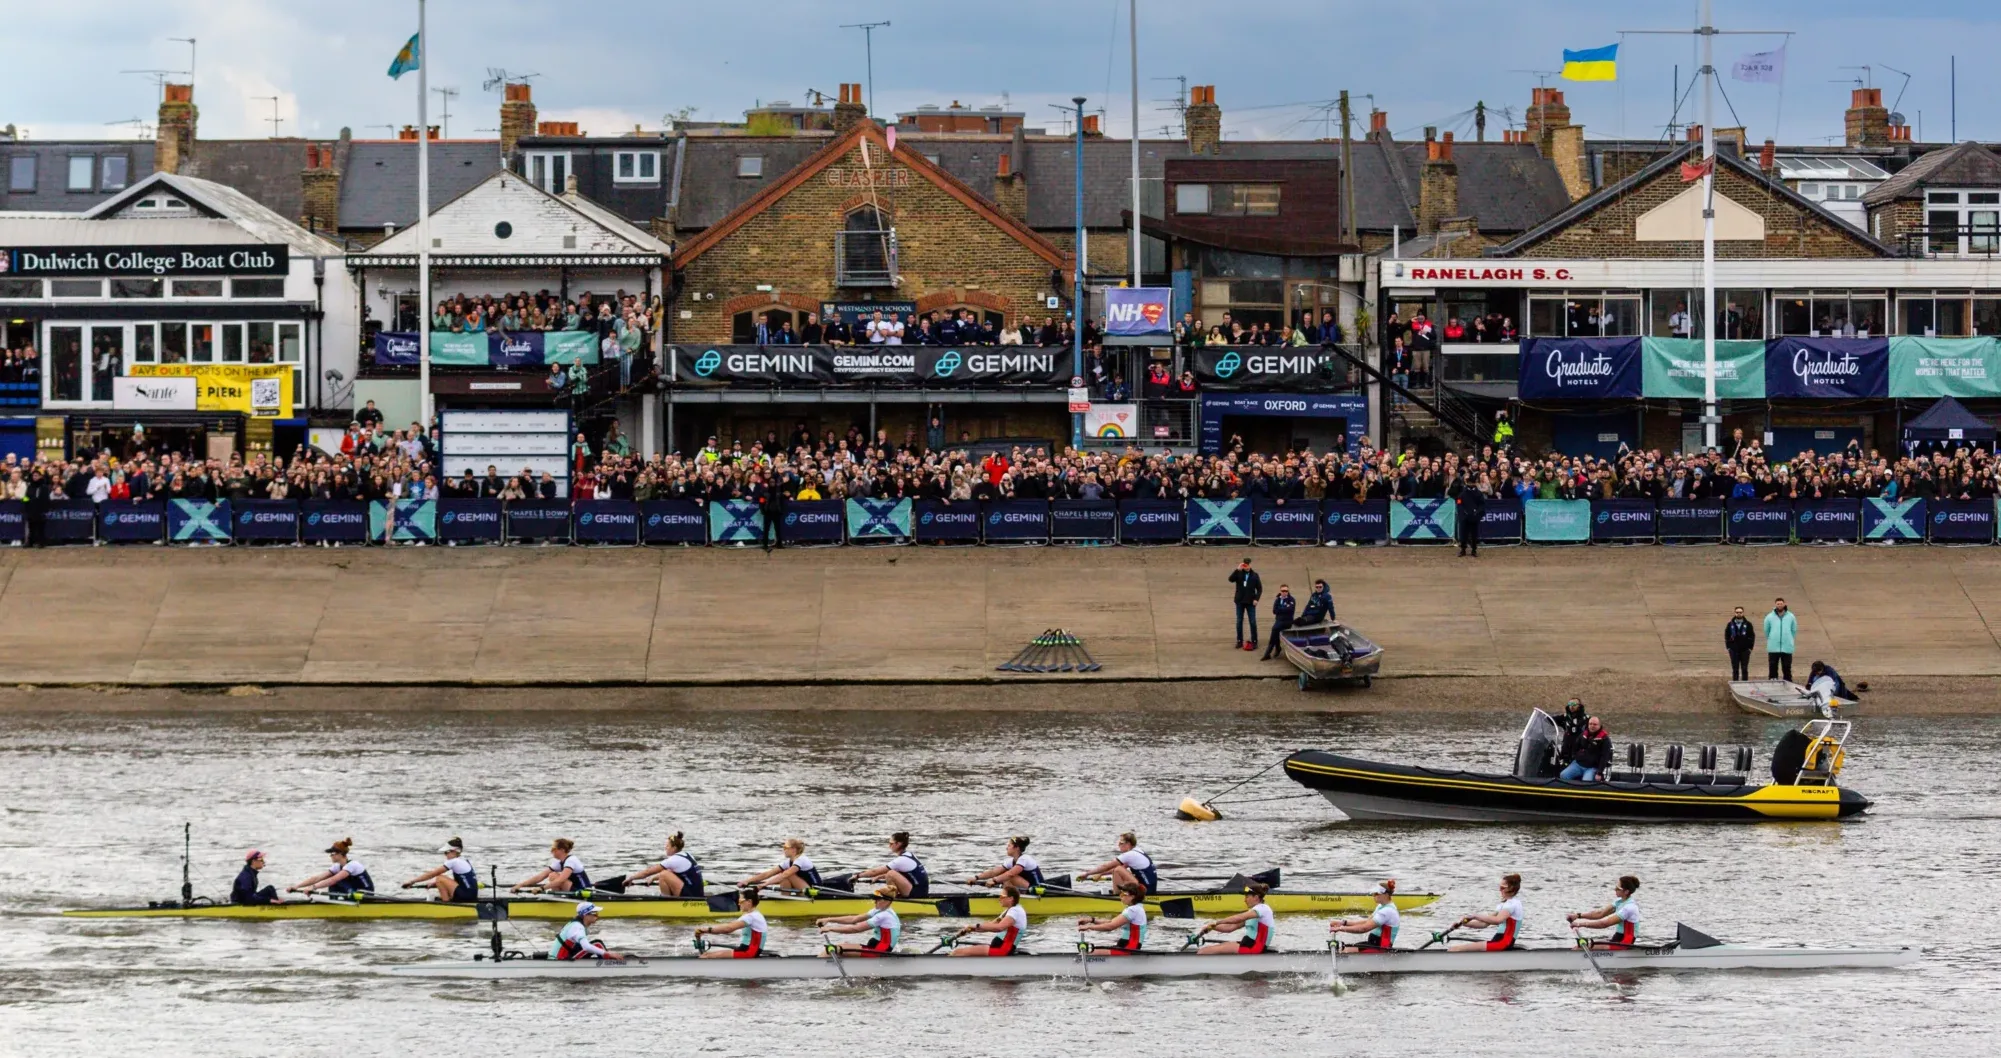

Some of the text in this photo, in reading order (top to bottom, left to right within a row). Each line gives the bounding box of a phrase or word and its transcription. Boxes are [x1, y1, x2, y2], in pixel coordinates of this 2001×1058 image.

[826, 169, 909, 187] CLASPER
[23, 251, 275, 273] Dulwich College Boat Club
[1411, 268, 1574, 280] RANELAGH S. C.
[727, 354, 814, 373] GEMINI
[833, 355, 915, 366] GEMINI.COM
[967, 354, 1054, 373] GEMINI
[1247, 355, 1330, 374] GEMIN
[1940, 358, 1957, 366] HERE
[1958, 358, 1971, 366] FOR
[1971, 358, 1983, 366] THE
[131, 366, 289, 377] SAVE OUR SPORTS ON THE RIVER
[1547, 350, 1613, 387] Graduate
[1793, 348, 1859, 386] Graduate
[1915, 367, 1943, 376] MOMENTS
[1945, 367, 1960, 376] THAT
[207, 387, 242, 398] PIER!
[1264, 400, 1307, 411] OXFORD
[119, 514, 160, 523] GEMINI
[255, 513, 294, 522] GEMINI
[322, 514, 362, 523] GEMINI
[457, 513, 497, 522] GEMINI
[595, 514, 635, 523] GEMINI
[663, 515, 703, 524] GEMINI
[799, 513, 839, 523] GEMINI
[935, 514, 976, 523] GEMINI
[1004, 513, 1044, 522] GEMINI
[1139, 513, 1180, 523] GEMINI
[1274, 512, 1314, 522] GEMINI
[1342, 514, 1382, 523] GEMINI
[1611, 512, 1651, 522] GEMINI
[1747, 511, 1787, 521] GEMINI
[1815, 512, 1855, 522] GEMINI
[1948, 513, 1989, 522] GEMINI
[1645, 948, 1660, 956] CUB
